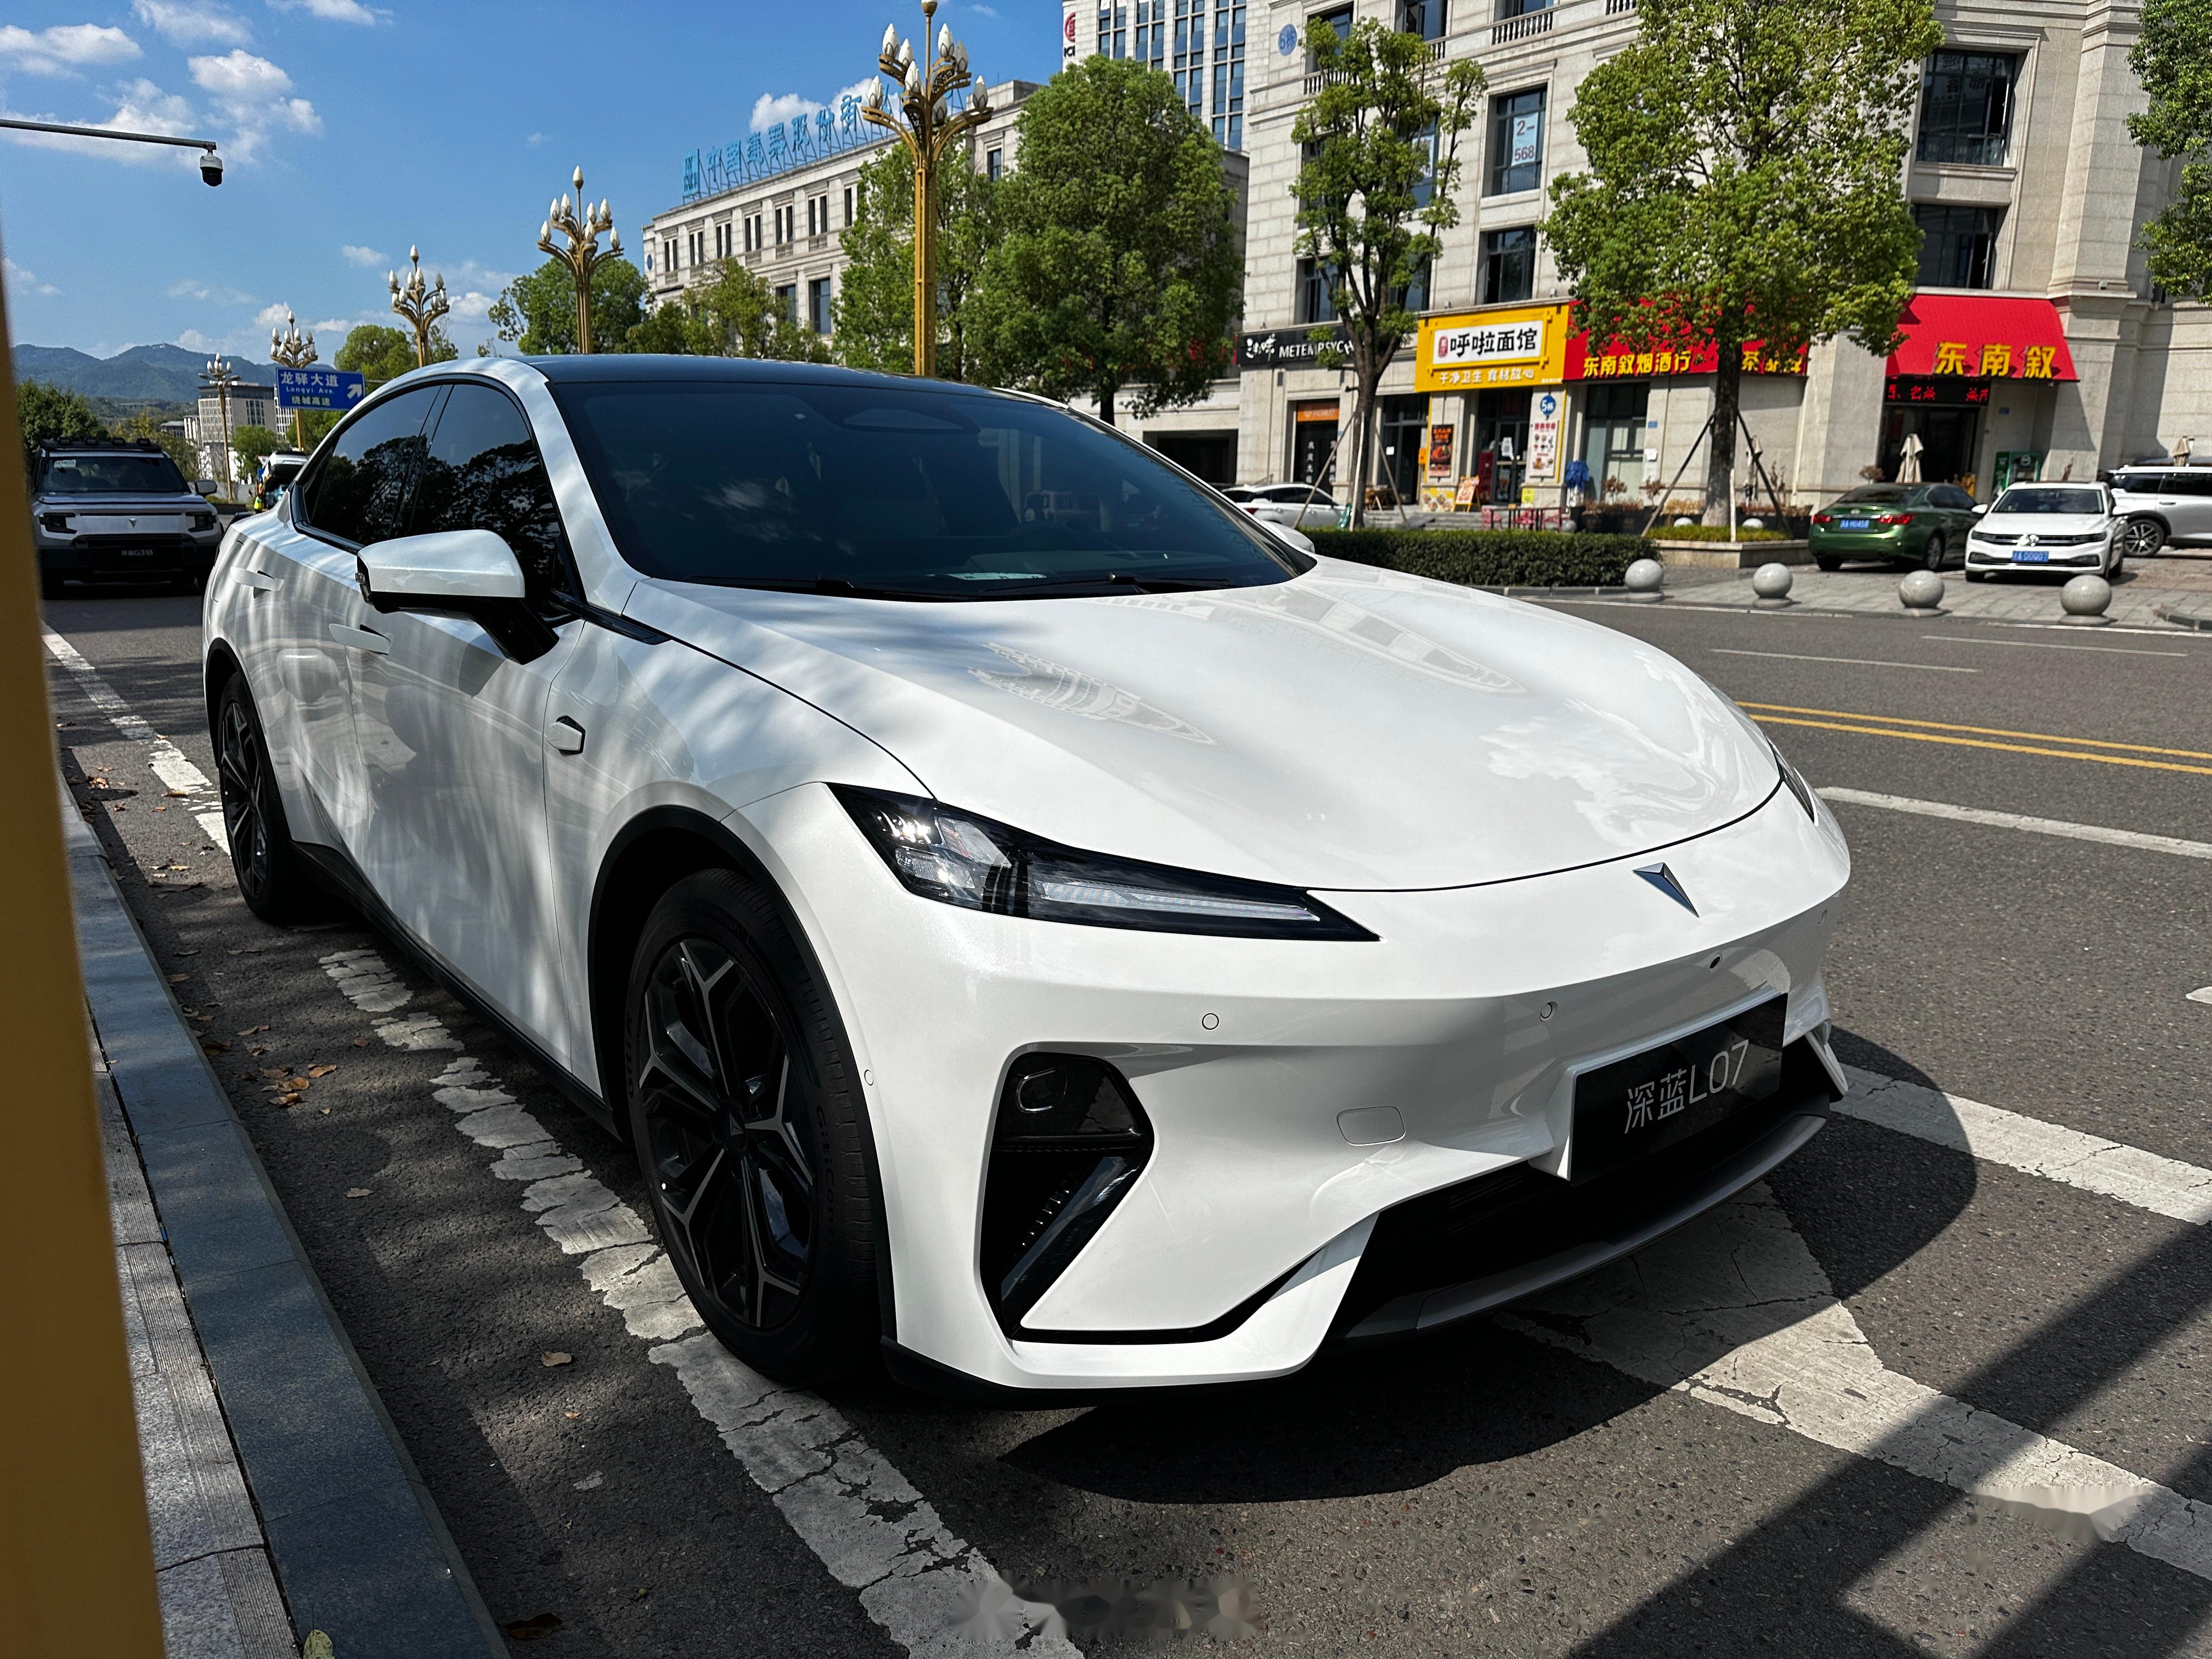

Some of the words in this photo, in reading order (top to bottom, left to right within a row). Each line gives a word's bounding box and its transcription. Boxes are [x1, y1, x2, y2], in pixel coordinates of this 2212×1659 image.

[1514, 145, 1534, 161] 568
[1450, 328, 1538, 358] 呼啦面馆
[1583, 351, 1691, 377] 东南叙烟酒行
[1934, 341, 2056, 379] 东南叙
[280, 371, 338, 387] 龙驿大道
[1440, 369, 1482, 385] 干净卫生
[291, 395, 331, 406] 绕城高速
[1624, 1039, 1750, 1135] 深蓝L07
